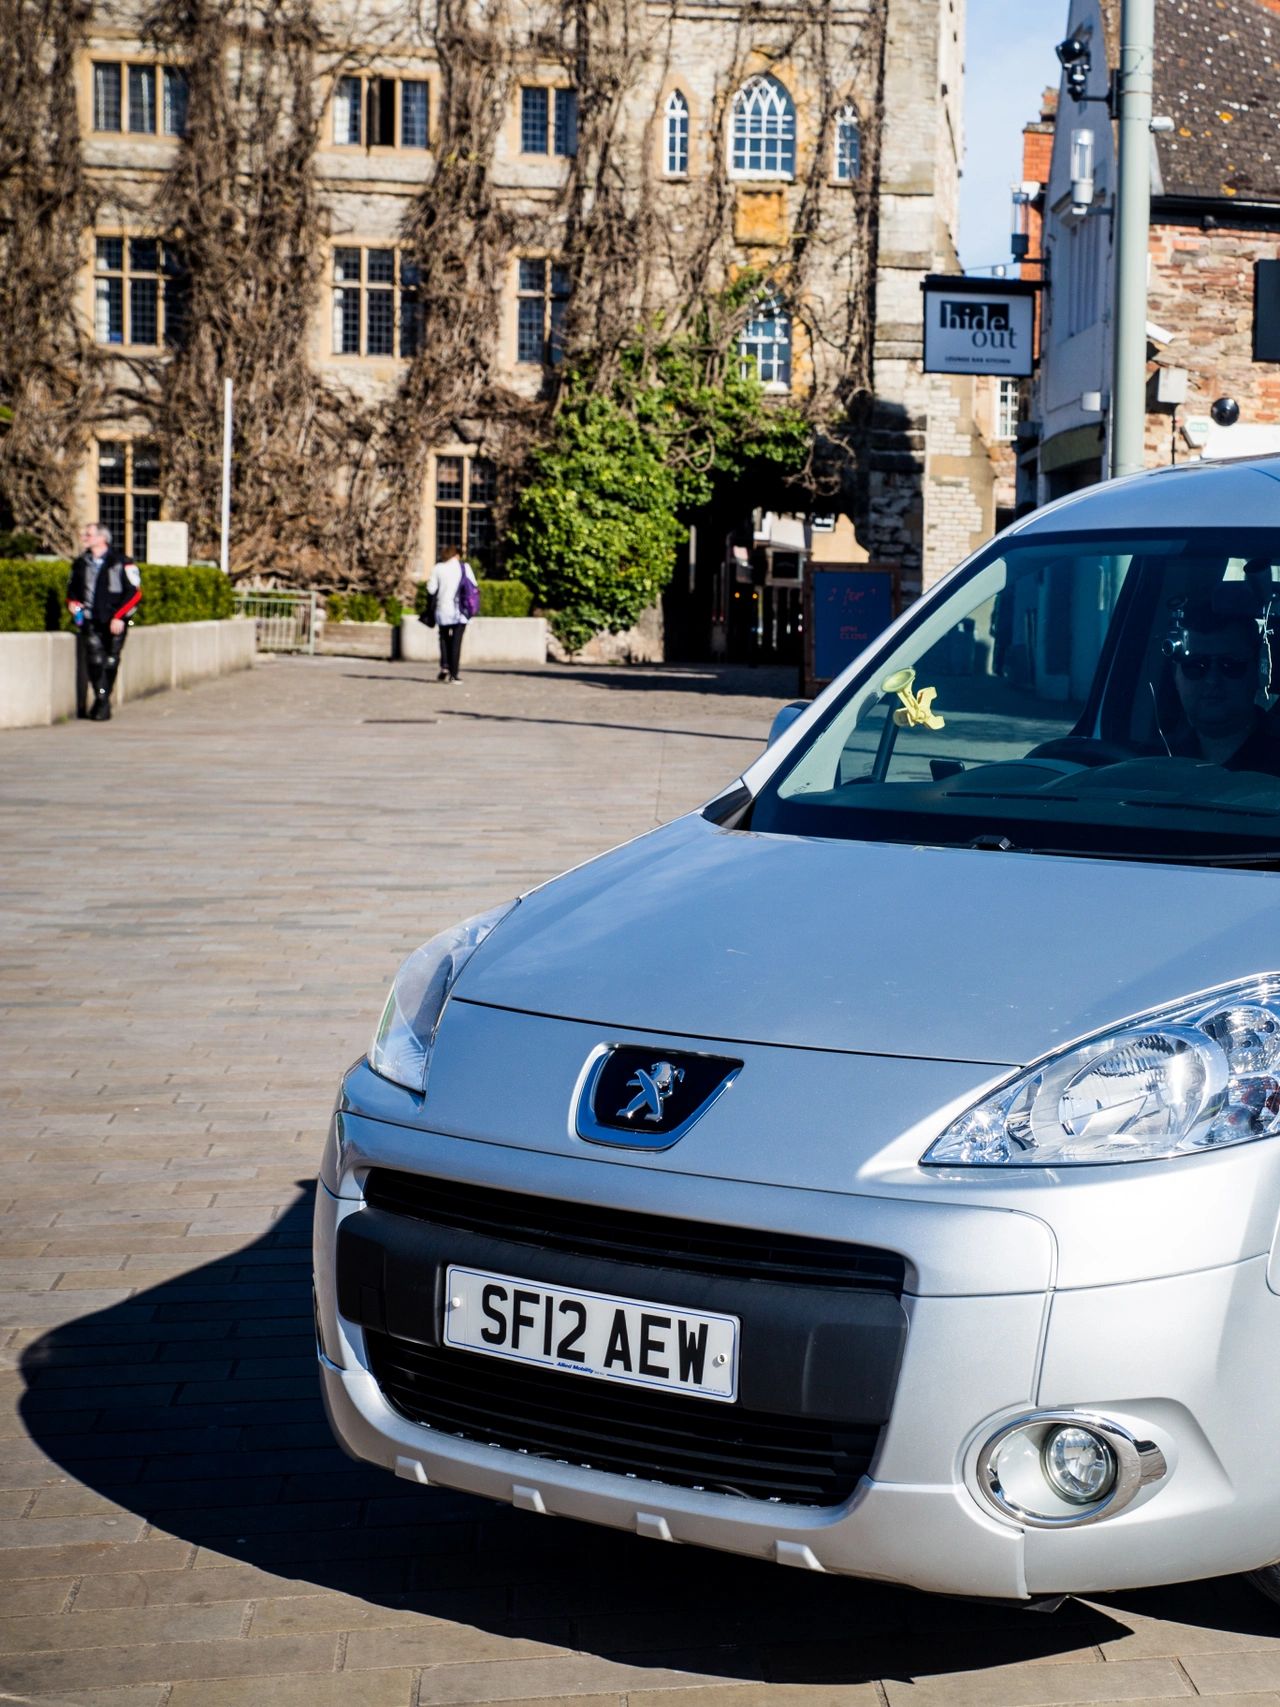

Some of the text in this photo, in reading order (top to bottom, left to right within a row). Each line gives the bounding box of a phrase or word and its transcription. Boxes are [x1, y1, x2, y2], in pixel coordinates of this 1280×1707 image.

[943, 303, 1006, 331] hide
[971, 327, 1018, 349] out
[480, 1283, 709, 1386] SF12 AEW
[572, 1364, 594, 1374] Mobility
